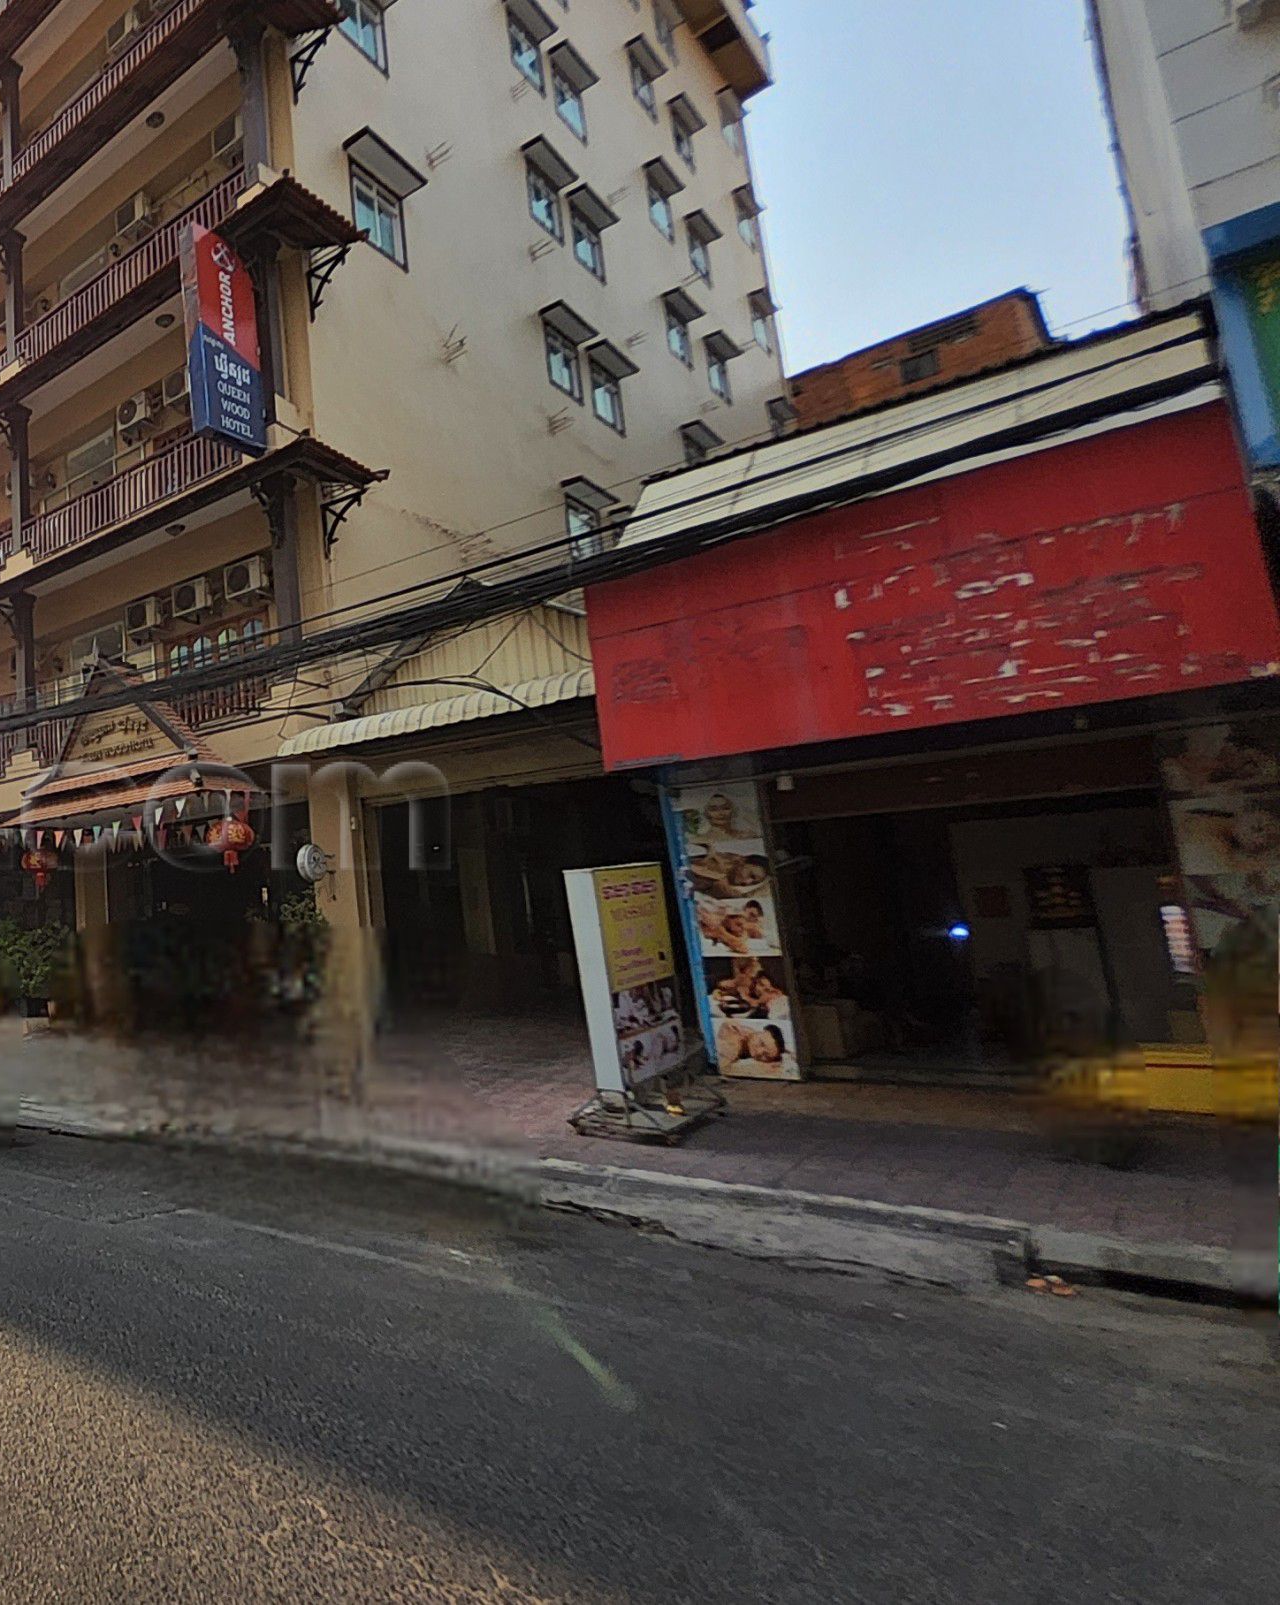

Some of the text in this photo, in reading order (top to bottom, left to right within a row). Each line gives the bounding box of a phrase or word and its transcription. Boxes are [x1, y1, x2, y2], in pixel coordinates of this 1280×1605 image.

[219, 270, 236, 346] ANCHOR
[217, 380, 251, 405] QUEEN
[221, 397, 251, 419] WOOD
[220, 414, 254, 439] HOTEL
